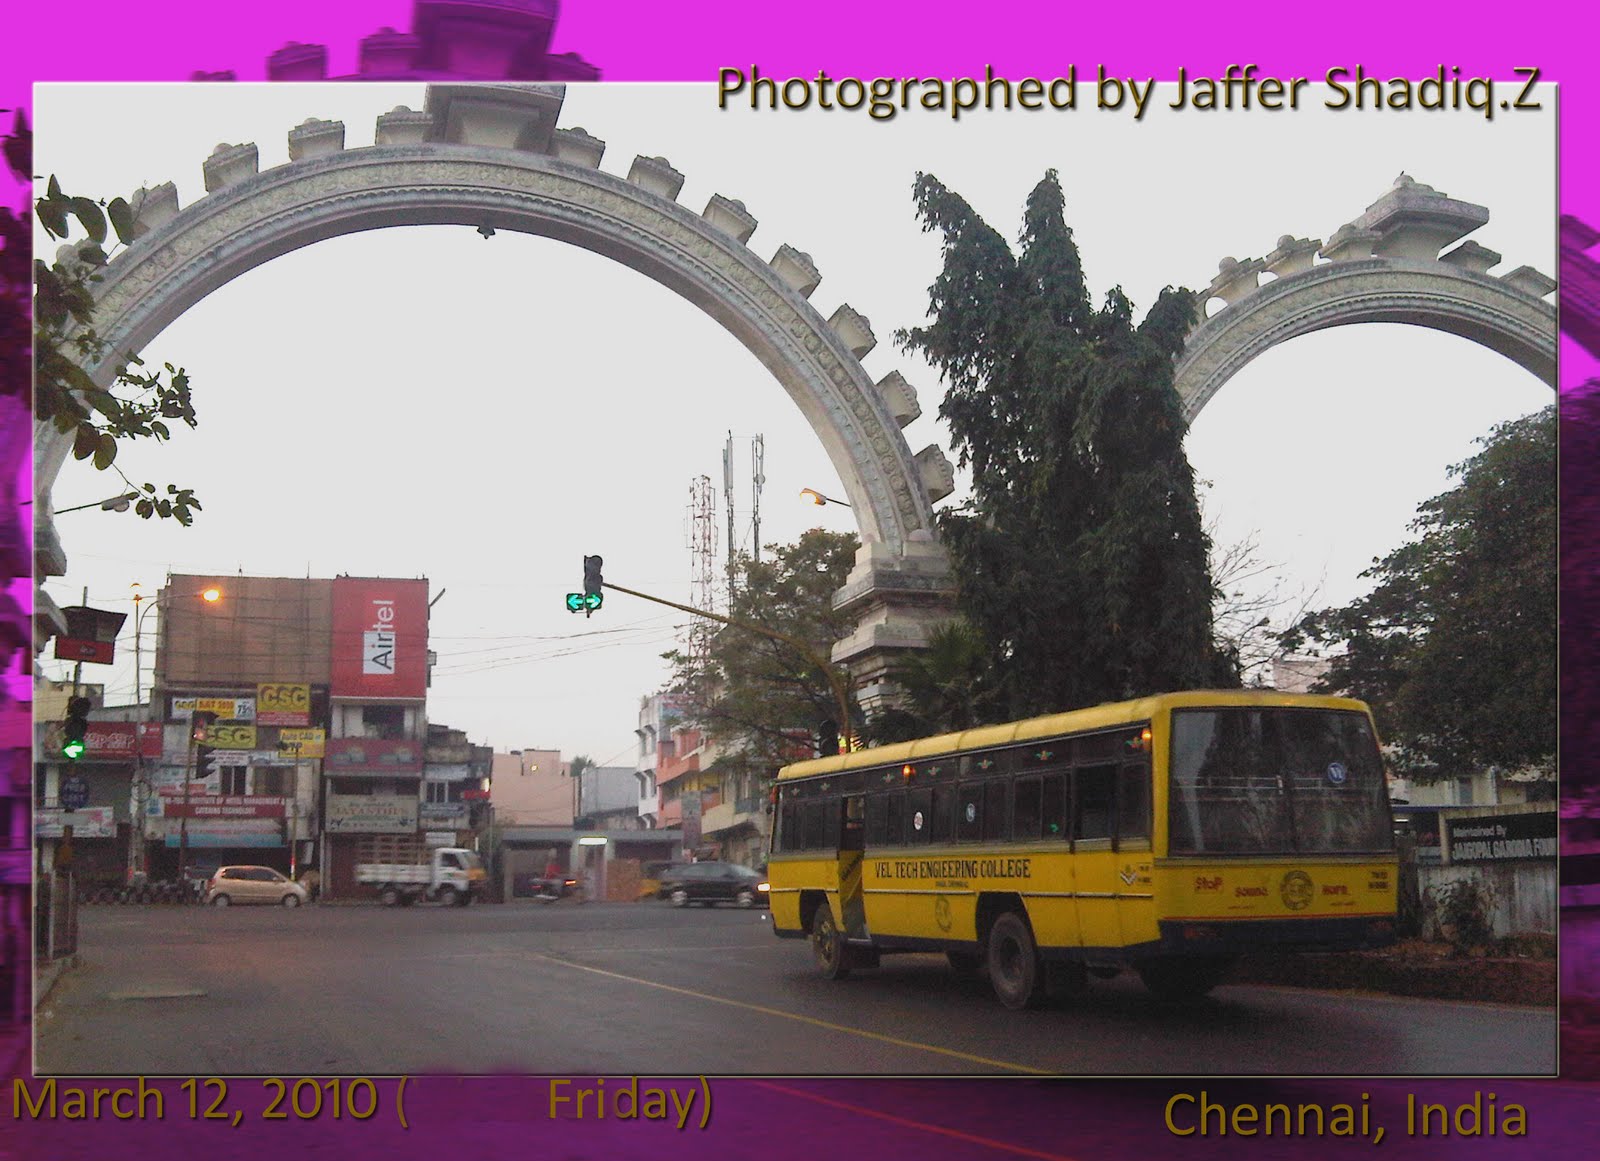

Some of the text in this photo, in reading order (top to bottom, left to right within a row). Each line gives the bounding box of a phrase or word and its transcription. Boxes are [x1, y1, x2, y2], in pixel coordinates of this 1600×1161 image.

[371, 599, 395, 671] Airtel
[261, 685, 307, 707] CSC
[875, 862, 892, 879] VEL
[895, 861, 918, 879] TECH
[980, 858, 1031, 879] COLLEGE
